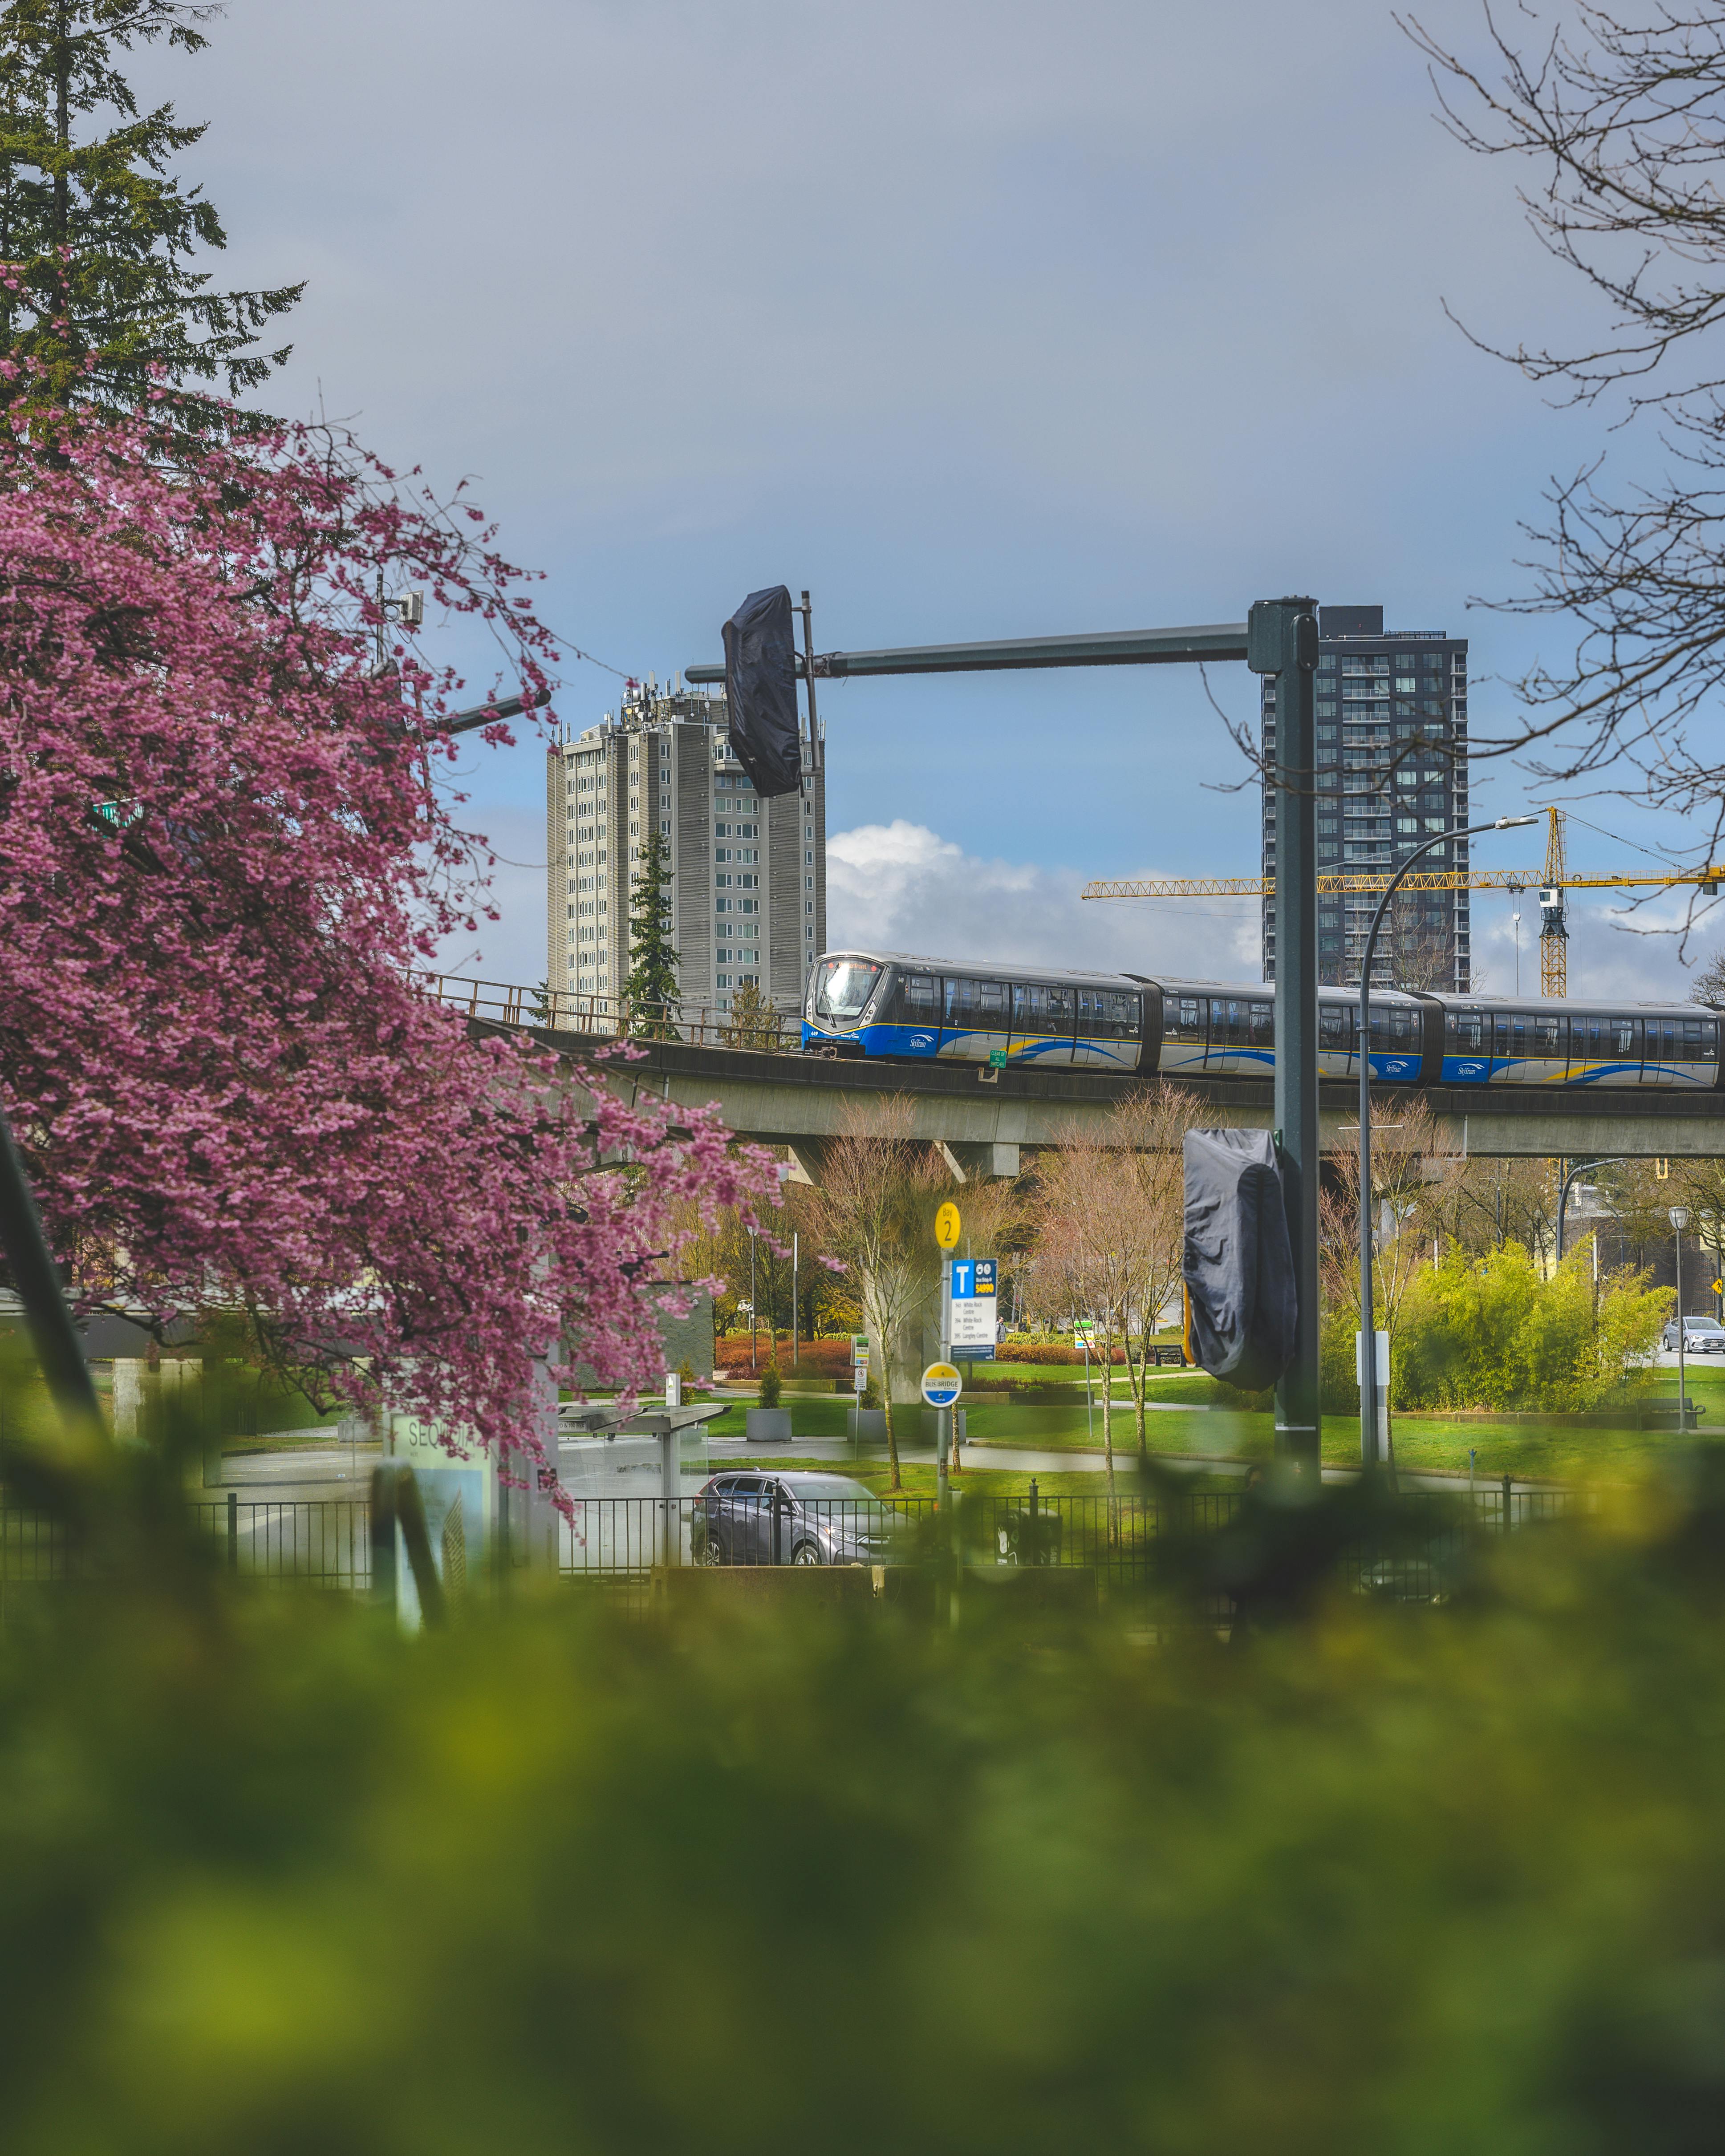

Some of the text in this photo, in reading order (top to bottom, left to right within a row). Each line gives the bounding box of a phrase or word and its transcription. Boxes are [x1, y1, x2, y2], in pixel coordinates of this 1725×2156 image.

[909, 1038, 926, 1049] SkyTrain
[1385, 1065, 1401, 1074] SkyTrain
[1458, 1067, 1476, 1076] SkyTrain
[943, 1208, 953, 1218] Bay
[944, 1220, 951, 1241] 2
[956, 1266, 969, 1294] T
